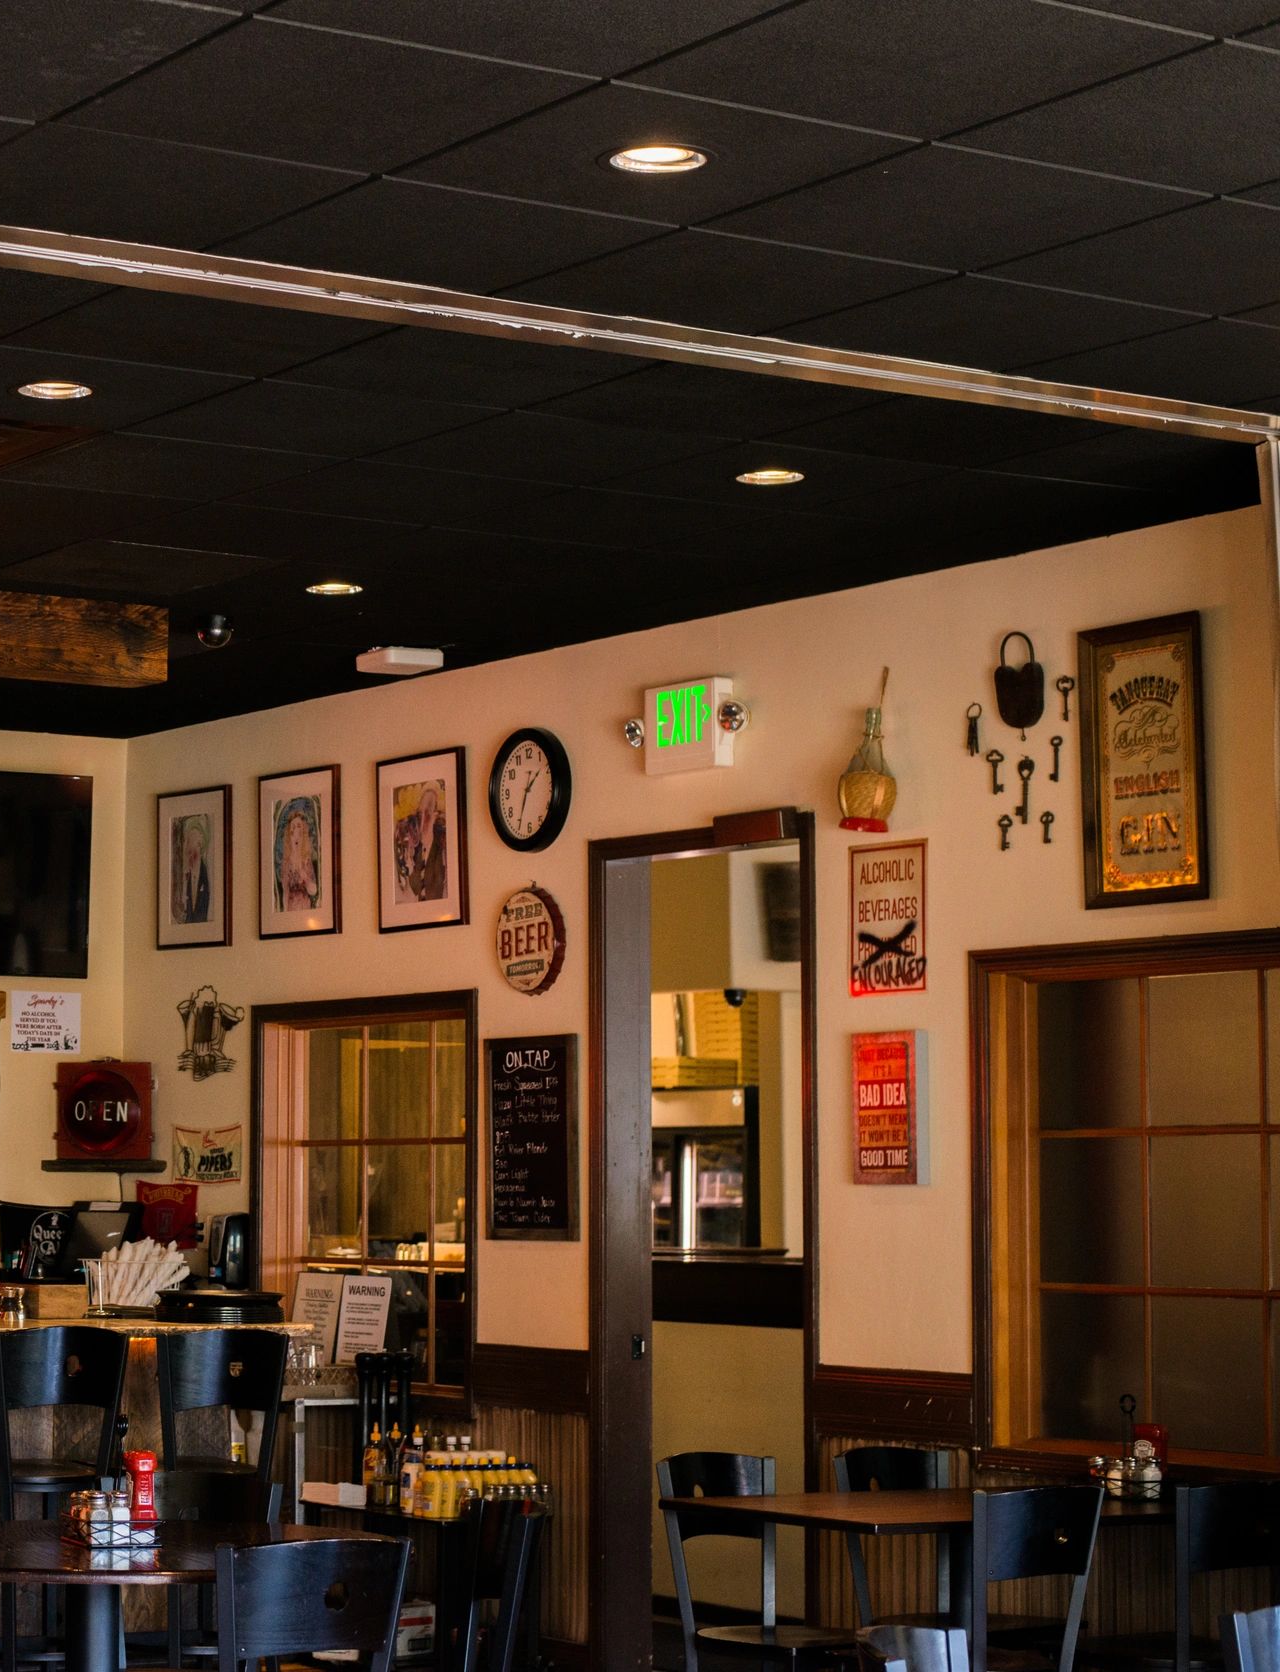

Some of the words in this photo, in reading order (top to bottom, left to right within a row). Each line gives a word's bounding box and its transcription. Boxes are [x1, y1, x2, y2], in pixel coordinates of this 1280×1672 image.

[1109, 674, 1180, 711] TANQUERAY
[656, 684, 706, 749] EXIT
[515, 755, 522, 767] 11
[525, 747, 533, 759] 12
[538, 751, 542, 763] 1
[508, 769, 516, 780] 10
[1114, 769, 1181, 798] ENGLISH
[505, 789, 510, 800] 9
[508, 806, 514, 819] 8
[527, 822, 532, 834] 6
[1120, 811, 1180, 855] GIN
[859, 858, 915, 885] ALCOHOLIC
[505, 902, 543, 922] FREE
[858, 896, 918, 923] BEVERAGES
[501, 921, 549, 960] BEER
[852, 956, 927, 991] ENCOURAGED
[505, 1050, 522, 1068] ON
[525, 1049, 550, 1067] TAP
[872, 1065, 885, 1077] IT'S
[887, 1064, 892, 1076] A
[859, 1083, 880, 1107] BAD
[883, 1082, 907, 1106] IDEA
[859, 1114, 886, 1128] DOESN'T
[889, 1113, 907, 1126] MEAN
[860, 1130, 865, 1143] IT
[868, 1130, 890, 1143] WON'T
[892, 1130, 901, 1142] BE
[197, 1151, 233, 1172] PIPERS
[860, 1150, 884, 1167] GOOD
[886, 1149, 909, 1166] TIME
[33, 1224, 66, 1242] Quee
[348, 1284, 386, 1297] WARNING
